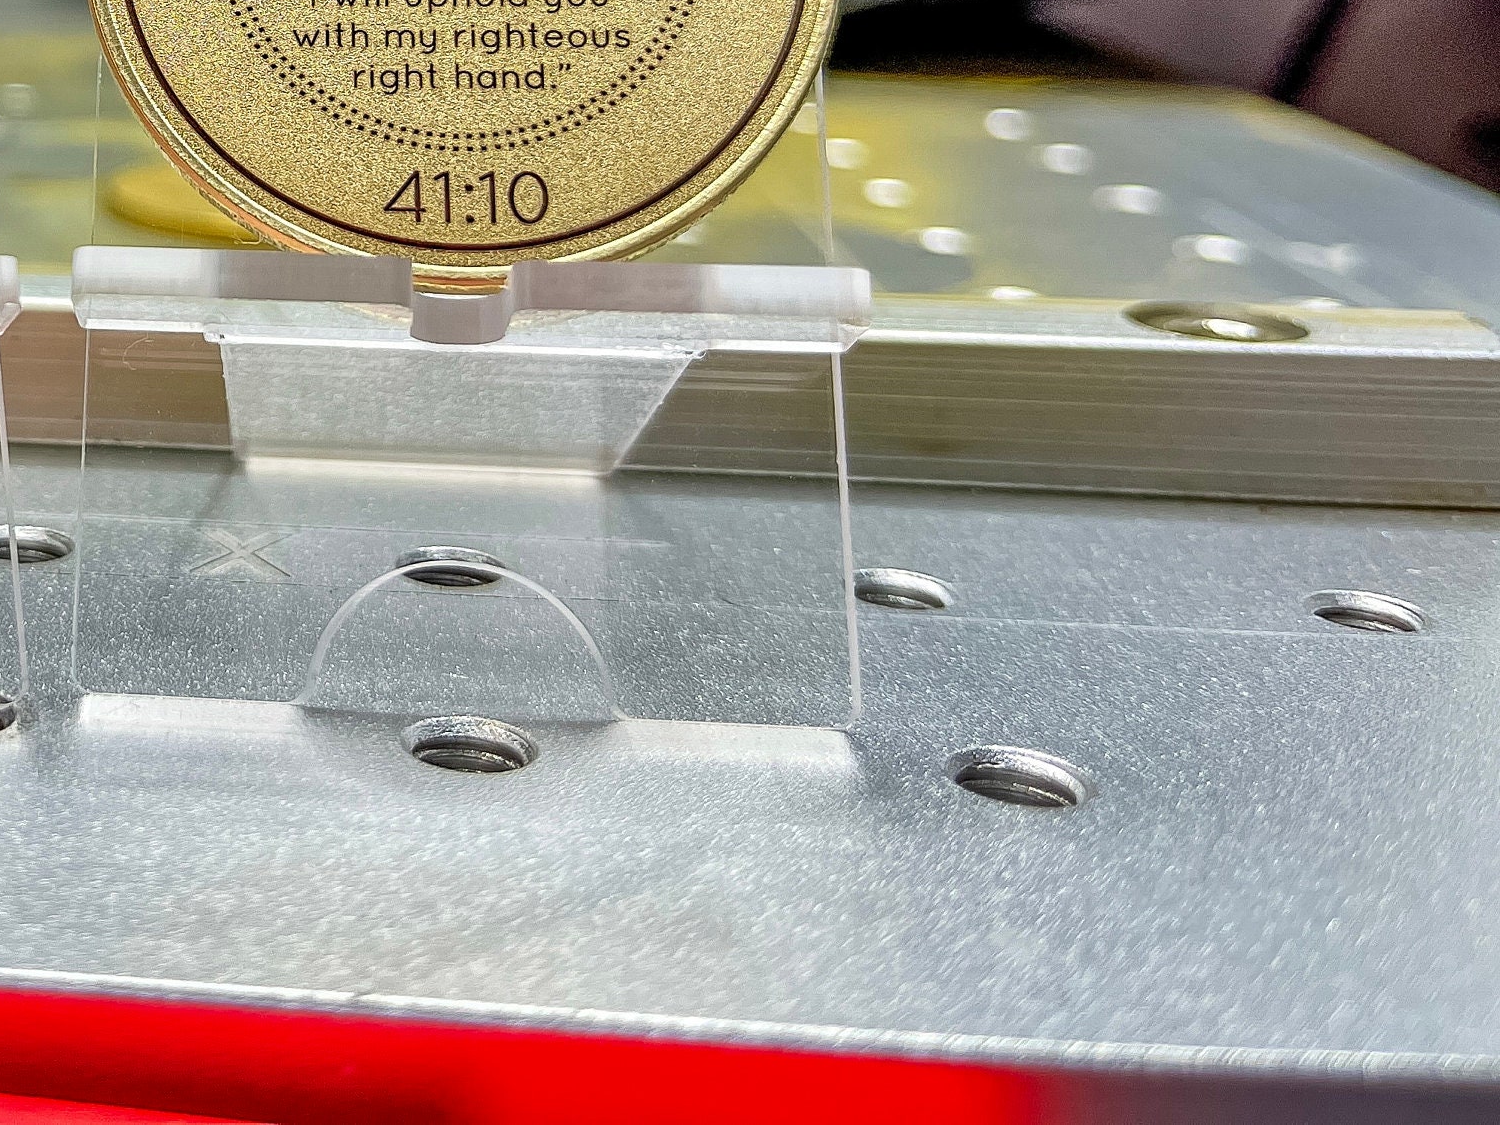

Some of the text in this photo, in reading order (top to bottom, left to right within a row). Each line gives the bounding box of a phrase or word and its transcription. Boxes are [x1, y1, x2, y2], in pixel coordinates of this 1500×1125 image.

[292, 23, 631, 54] with my righteous
[354, 63, 571, 94] right hand.”
[383, 169, 551, 226] 41:10
